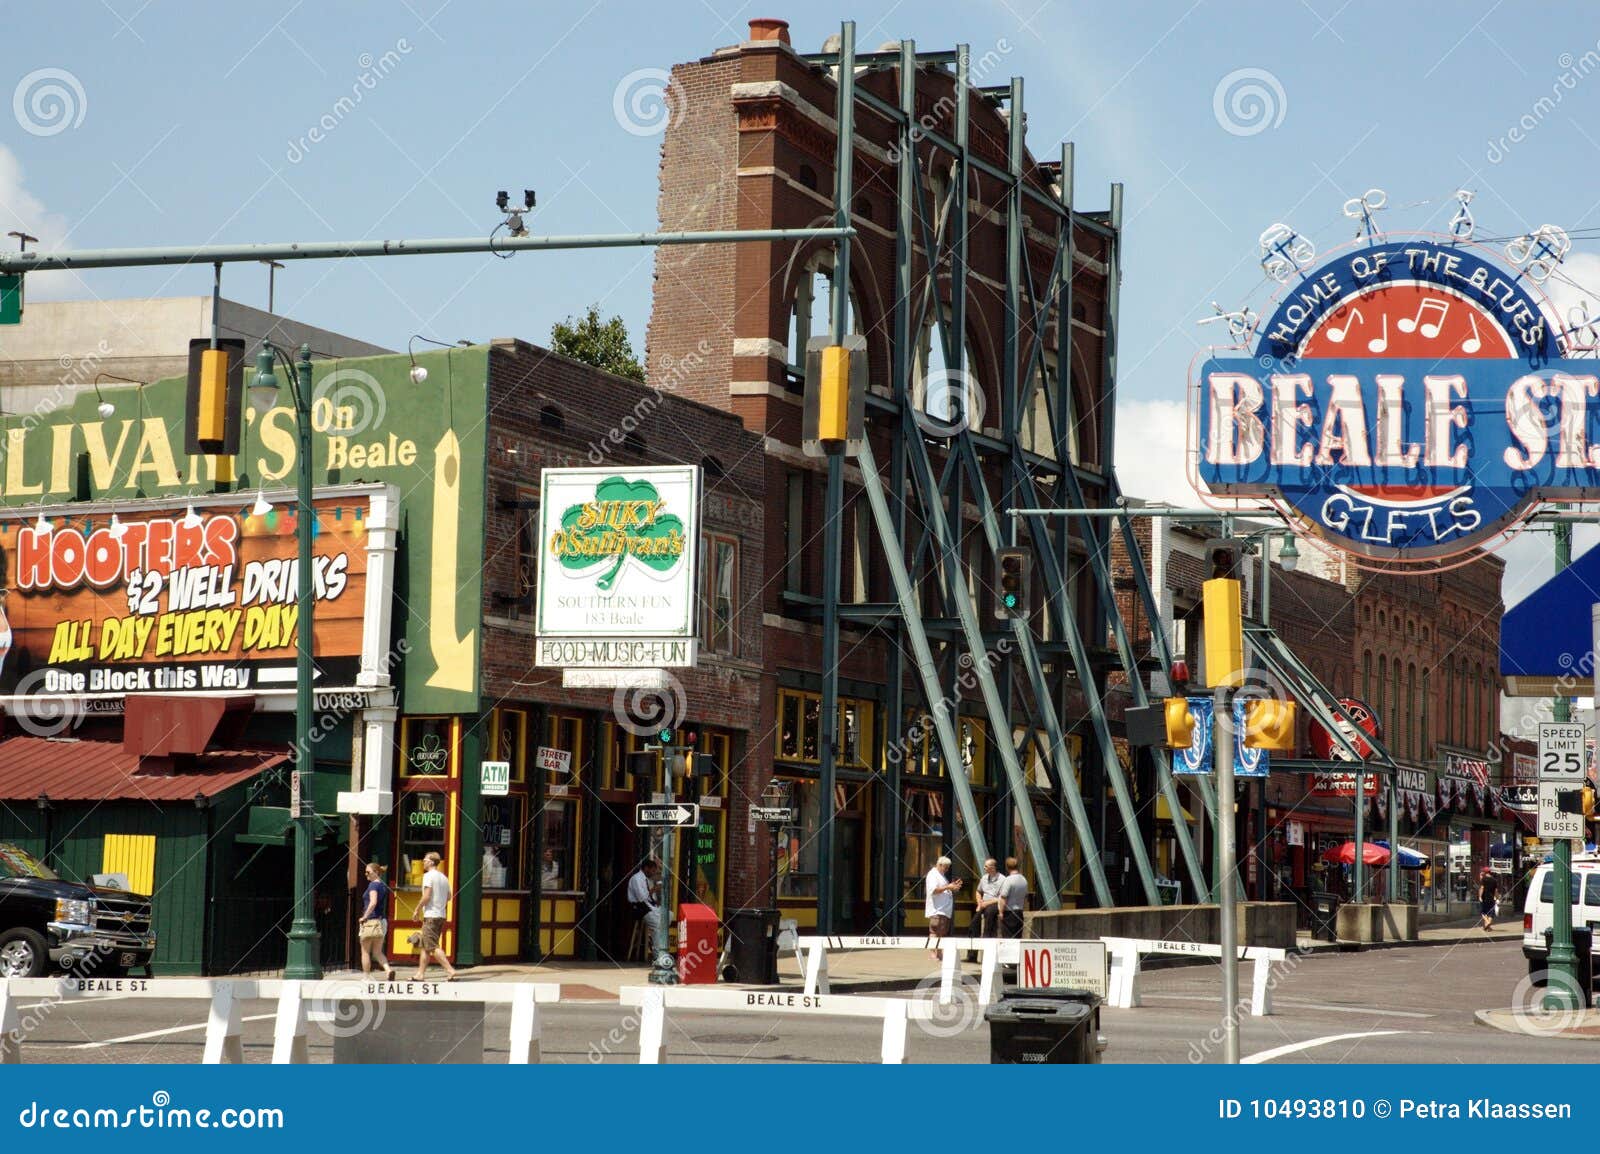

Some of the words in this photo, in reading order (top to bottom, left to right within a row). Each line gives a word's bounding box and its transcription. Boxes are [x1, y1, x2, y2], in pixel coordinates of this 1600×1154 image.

[1268, 272, 1342, 344] HOME
[1352, 251, 1388, 277] OF
[1405, 248, 1463, 280] THE
[1469, 265, 1544, 348] BLUES
[312, 397, 354, 432] On
[1206, 373, 1467, 468] BEALE
[326, 432, 417, 471] Beale
[1321, 493, 1482, 544] GIFTS
[17, 515, 237, 589] HOOTERS
[128, 567, 162, 615] $2
[167, 564, 235, 611] WELL
[557, 595, 640, 609] SOUTHERN
[643, 595, 672, 609] FUN
[585, 612, 605, 625] 183
[609, 612, 644, 625] Beale
[48, 621, 94, 664] ALL
[100, 615, 153, 661] DAY
[156, 609, 242, 657] EVERY
[45, 669, 85, 692] One
[90, 667, 149, 691] Block
[154, 666, 196, 689] this
[202, 664, 250, 690] Way
[1543, 728, 1582, 739] SPEED
[1547, 740, 1577, 750] LIMIT
[540, 749, 569, 762] STREET
[1544, 752, 1581, 773] 25
[544, 759, 560, 770] BAR
[483, 765, 507, 782] ATM
[419, 798, 435, 812] NO
[1541, 799, 1559, 807] TRU
[410, 812, 442, 827] COVER
[644, 810, 660, 820] ONE
[662, 810, 679, 819] WAY
[1554, 811, 1568, 820] OR
[1543, 821, 1579, 832] BUSES
[1157, 942, 1186, 951] BEALE
[1024, 948, 1052, 988] NO
[78, 981, 126, 992] BEALE
[368, 983, 414, 994] BEALE
[747, 993, 795, 1006] BEALE
